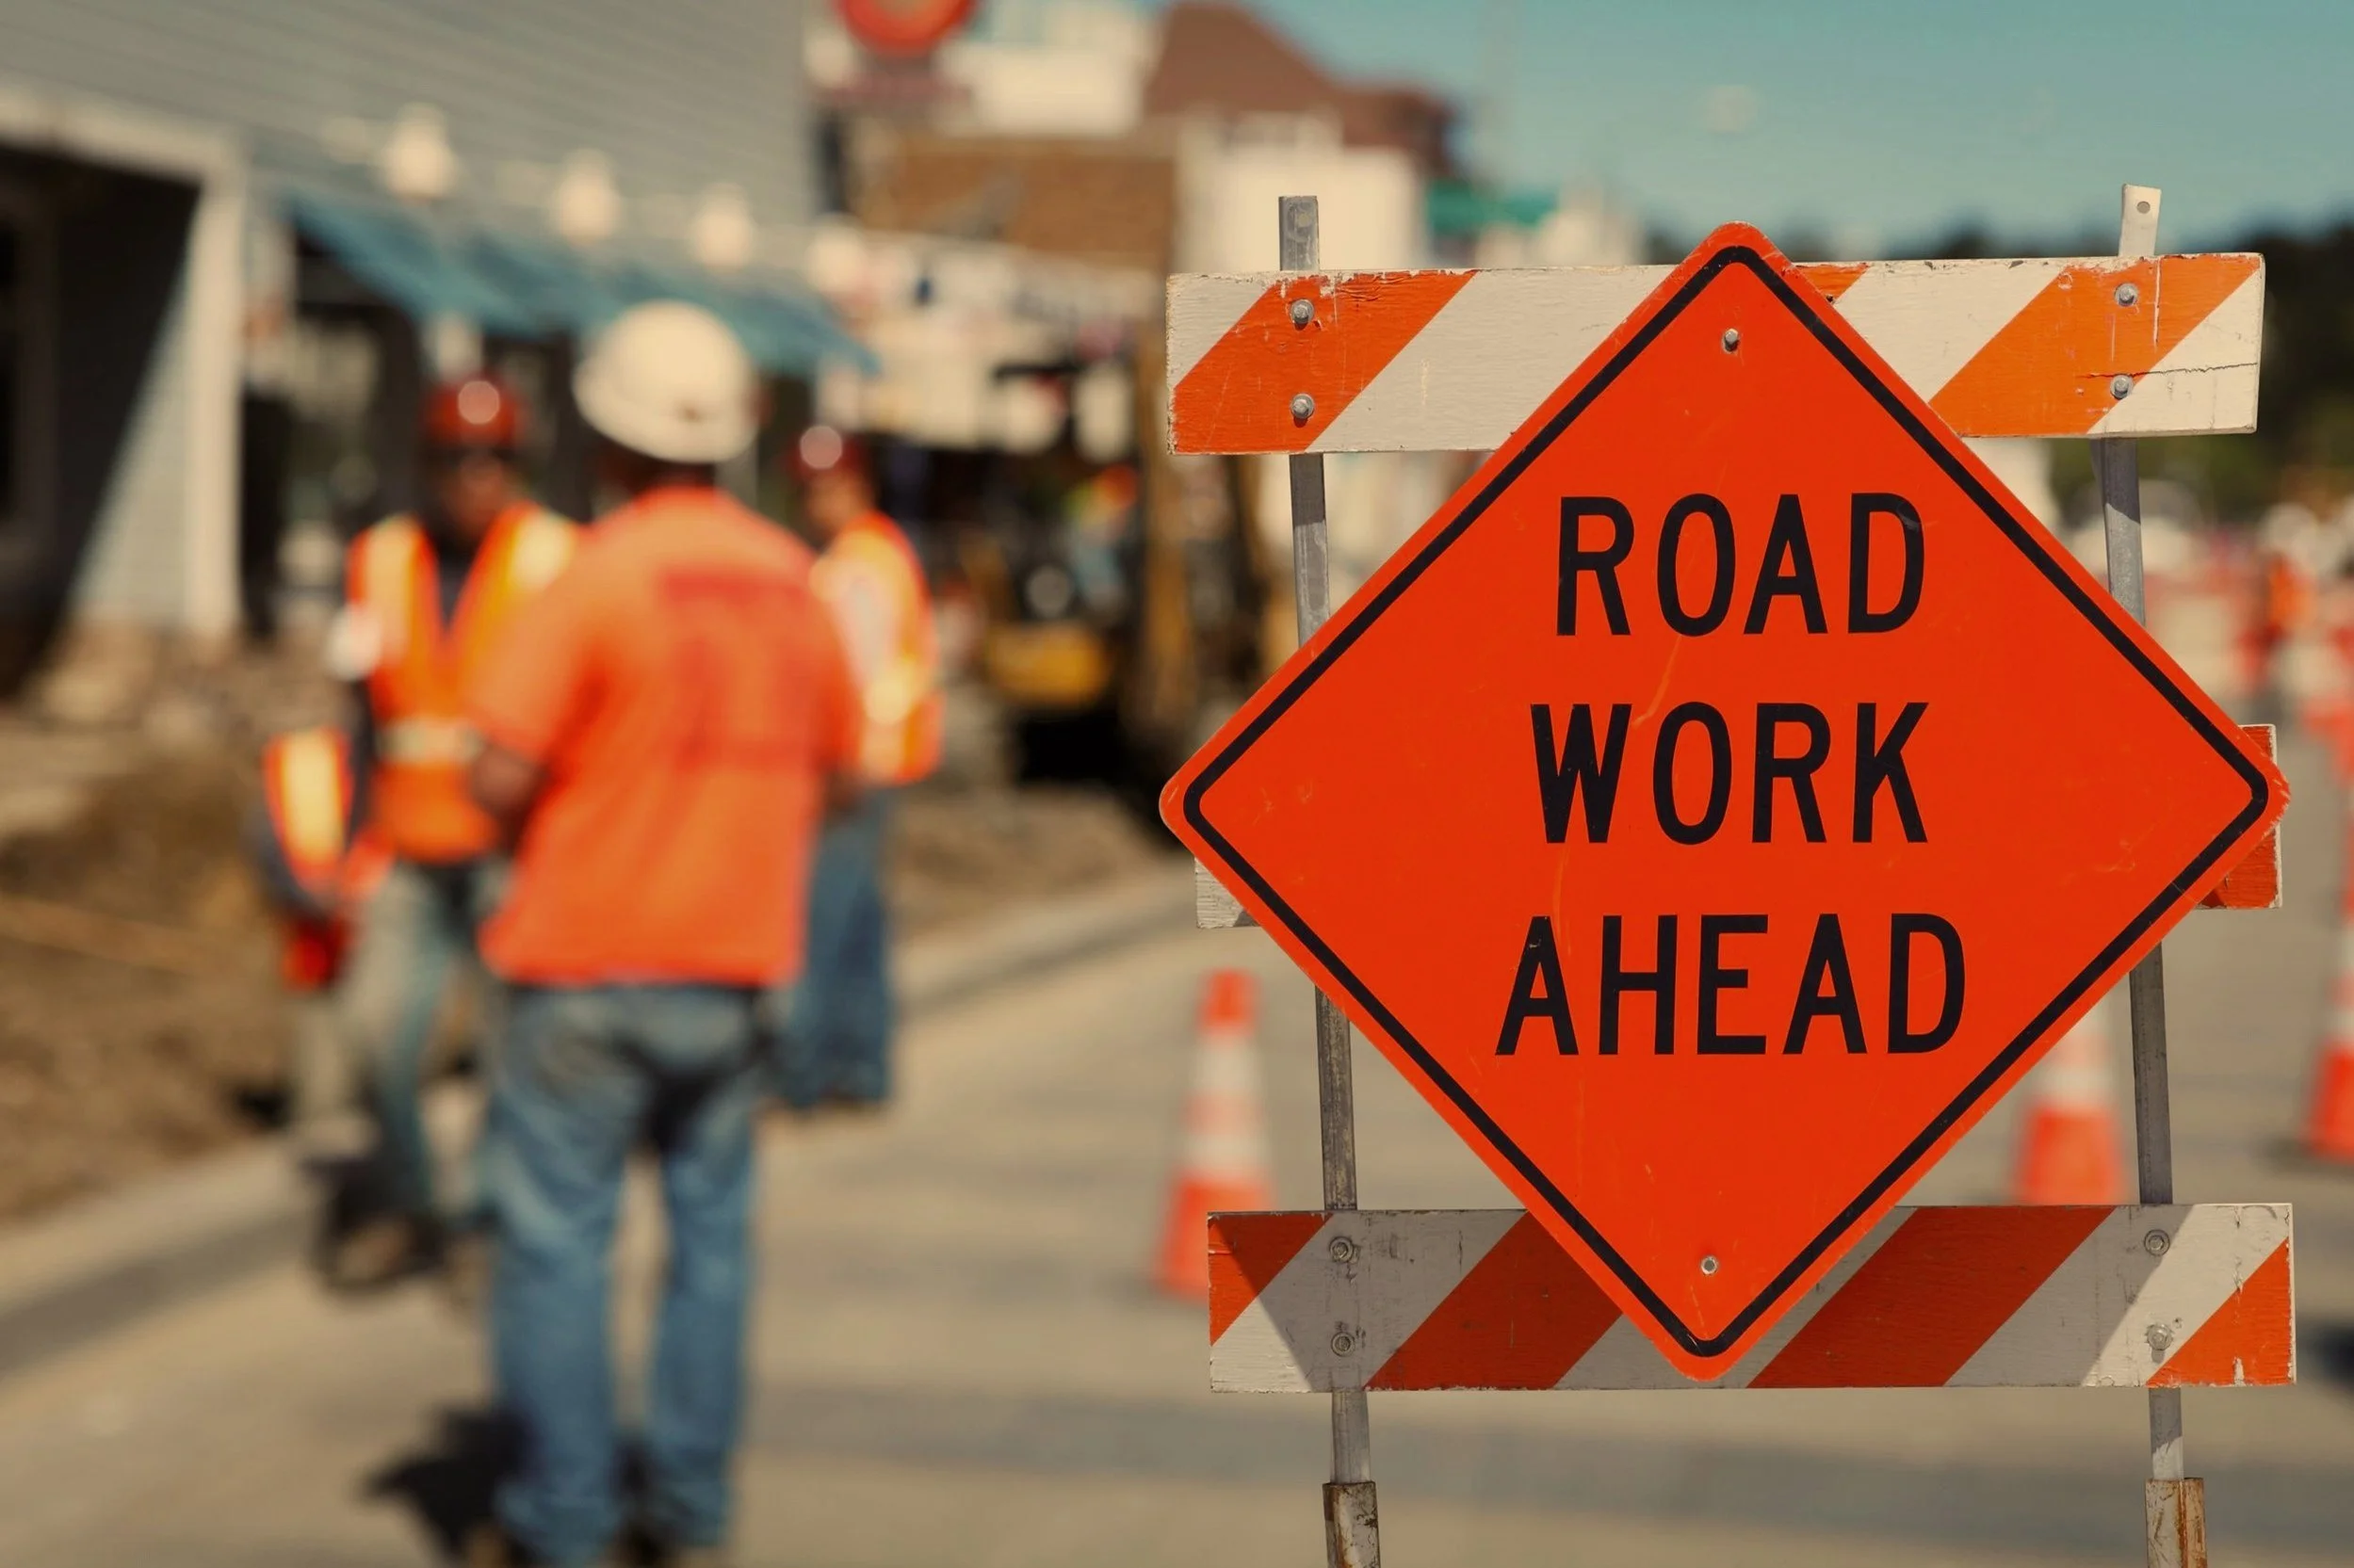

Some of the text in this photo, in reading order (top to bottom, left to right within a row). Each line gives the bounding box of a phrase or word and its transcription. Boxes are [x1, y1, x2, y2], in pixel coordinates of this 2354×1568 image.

[1557, 493, 1924, 637] ROAD
[1531, 702, 1928, 846] WORK
[1496, 913, 1965, 1057] AHEAD
